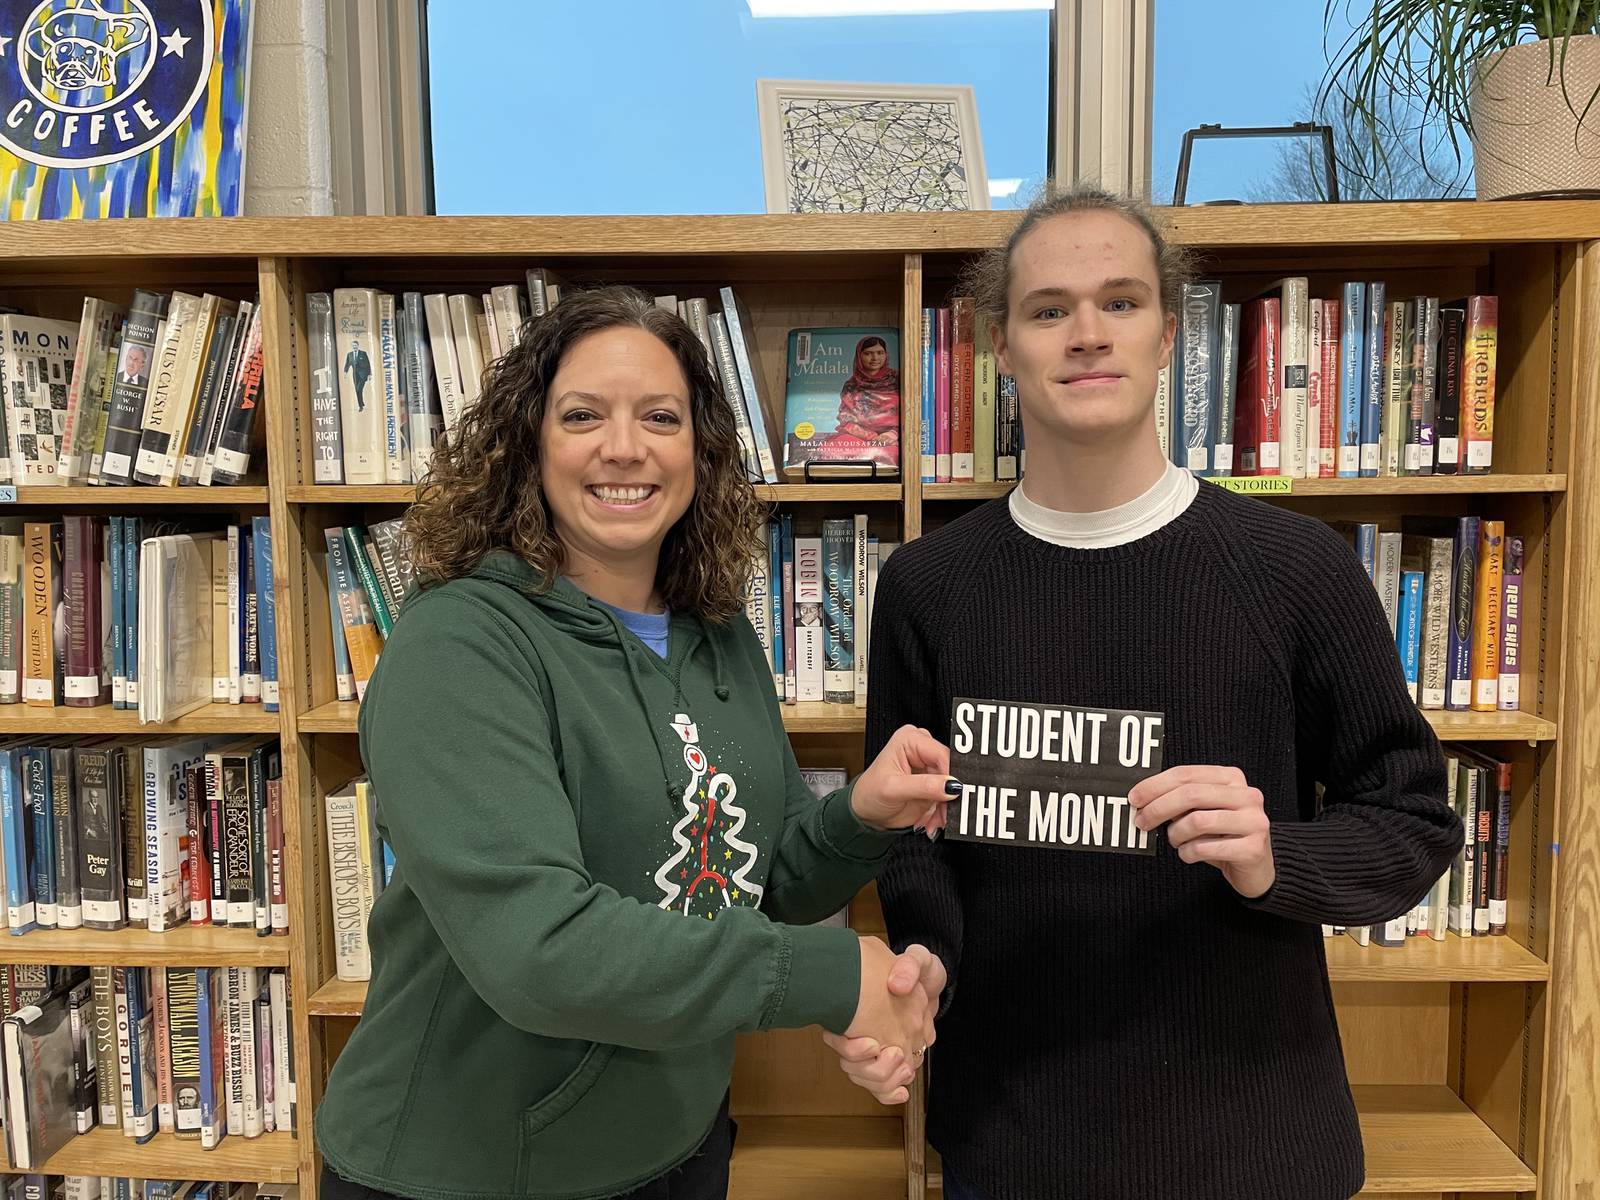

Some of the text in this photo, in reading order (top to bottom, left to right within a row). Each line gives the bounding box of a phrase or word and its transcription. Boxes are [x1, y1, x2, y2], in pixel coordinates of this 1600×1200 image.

[6, 98, 160, 148] COFFEE
[12, 330, 79, 351] MON
[127, 323, 155, 334] DECISION
[129, 330, 150, 339] POINTS
[381, 319, 396, 369] REAGAN
[1393, 306, 1403, 366] JACK FINNEY
[717, 335, 730, 362] WOMAN
[815, 343, 842, 356] Am
[722, 364, 736, 394] AGAINST
[795, 358, 849, 376] Malala
[116, 388, 143, 399] GEORGE
[116, 404, 135, 412] BUSH
[150, 371, 173, 425] CAESAR
[314, 398, 337, 411] HAVE
[443, 375, 456, 416] The Only
[963, 385, 972, 422] GOTHIC
[315, 430, 338, 442] RIGHT
[316, 417, 335, 425] THE
[953, 407, 961, 431] OATES
[319, 445, 335, 460] TO
[386, 415, 397, 460] PRESIDENT
[25, 464, 55, 474] TED
[1233, 480, 1289, 491] STORIES
[825, 529, 854, 537] HERBERT
[31, 535, 48, 618] WOODEN
[331, 537, 354, 625] FROM THE ASHES
[376, 535, 405, 598] Truman
[800, 548, 818, 598] ROBIN
[1384, 543, 1394, 611] MODERN MASTERS
[71, 571, 85, 650] CHARLES DARWIN
[367, 580, 382, 613] THOREAU
[753, 575, 770, 650] Educated
[829, 552, 841, 669] WOODROW WILSON
[843, 576, 853, 642] The Ordeal of
[1459, 557, 1473, 638] Murder for Love
[1486, 552, 1498, 669] CART NECESSARY NOISE
[31, 628, 42, 656] SETH
[248, 593, 257, 662] HEART'S WORK
[1428, 574, 1443, 690] MORE WILD WESTERNS
[1504, 585, 1519, 666] new skies
[954, 702, 1162, 768] STUDENT OF
[32, 759, 44, 790] God's
[79, 755, 107, 766] FREUD
[53, 775, 61, 816] FRANKLIN
[60, 775, 68, 816] BENJAMIN
[205, 760, 215, 797] HITMAN
[801, 774, 843, 784] MAKER
[1469, 774, 1477, 806] FINDING
[34, 792, 44, 816] Fool
[330, 802, 354, 810] Crouch
[959, 784, 1018, 840] THE
[146, 772, 158, 884] GROWING SEASON
[226, 808, 239, 878] EPIC GRANDEUR
[237, 810, 250, 876] SOME SORT OF
[87, 854, 109, 866] Peter
[89, 865, 107, 877] Gay
[331, 812, 361, 930] THE BISHOP'S BOYS
[0, 967, 8, 985] THE
[15, 971, 46, 983] HISS
[228, 966, 239, 1000] EBRON
[93, 966, 112, 1052] THE BOYS
[169, 972, 200, 1078] STONEWALL JACKSON
[229, 1001, 241, 1034] JAMES
[117, 1005, 131, 1092] GORDIE
[158, 1024, 166, 1053] JACKSON
[107, 1060, 115, 1076] RON
[231, 1044, 241, 1069] BUZZ
